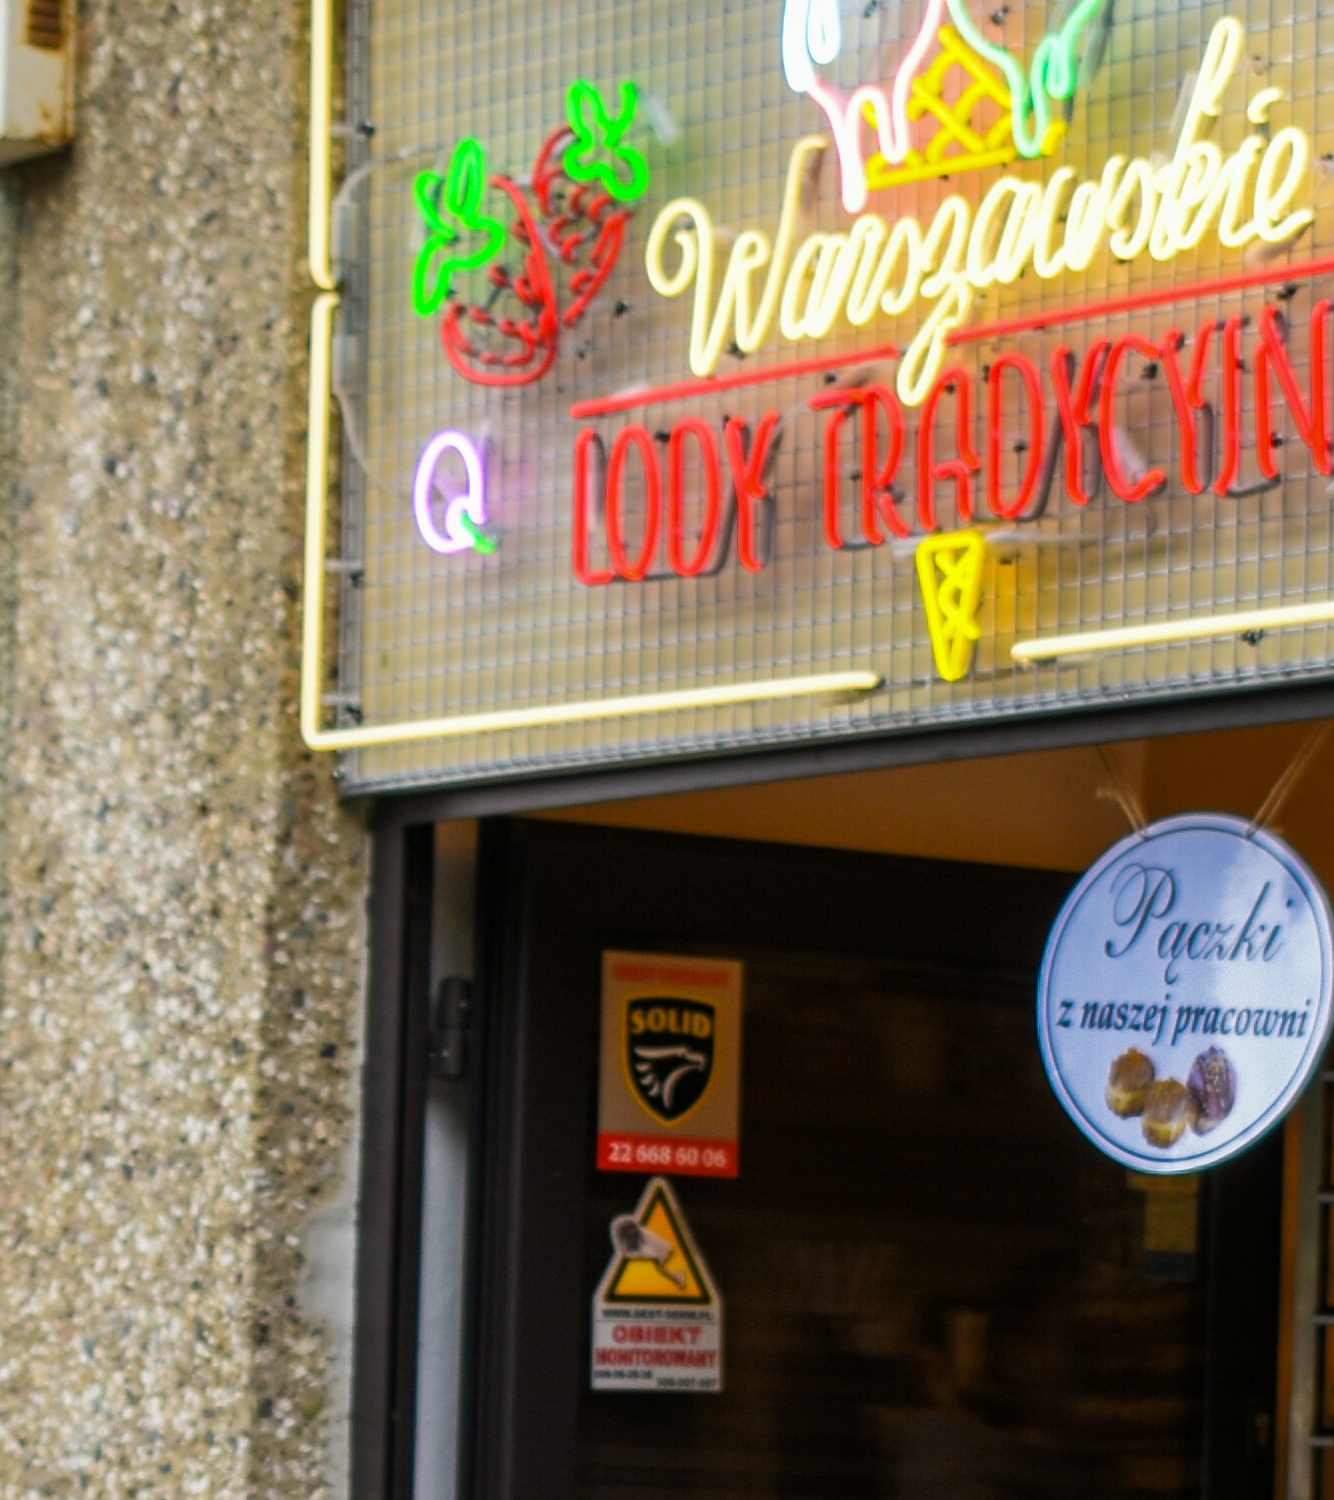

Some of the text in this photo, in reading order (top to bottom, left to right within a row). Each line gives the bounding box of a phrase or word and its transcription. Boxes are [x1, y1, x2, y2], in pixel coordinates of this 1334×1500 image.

[644, 15, 1316, 408] Warszawskie
[572, 408, 783, 586] LODY
[1104, 863, 1294, 985] Pączki
[630, 1007, 712, 1038] SOLID
[1056, 993, 1312, 1047] z naszej pracowni
[609, 1143, 631, 1163] 22
[612, 1325, 702, 1344] OBIEKT
